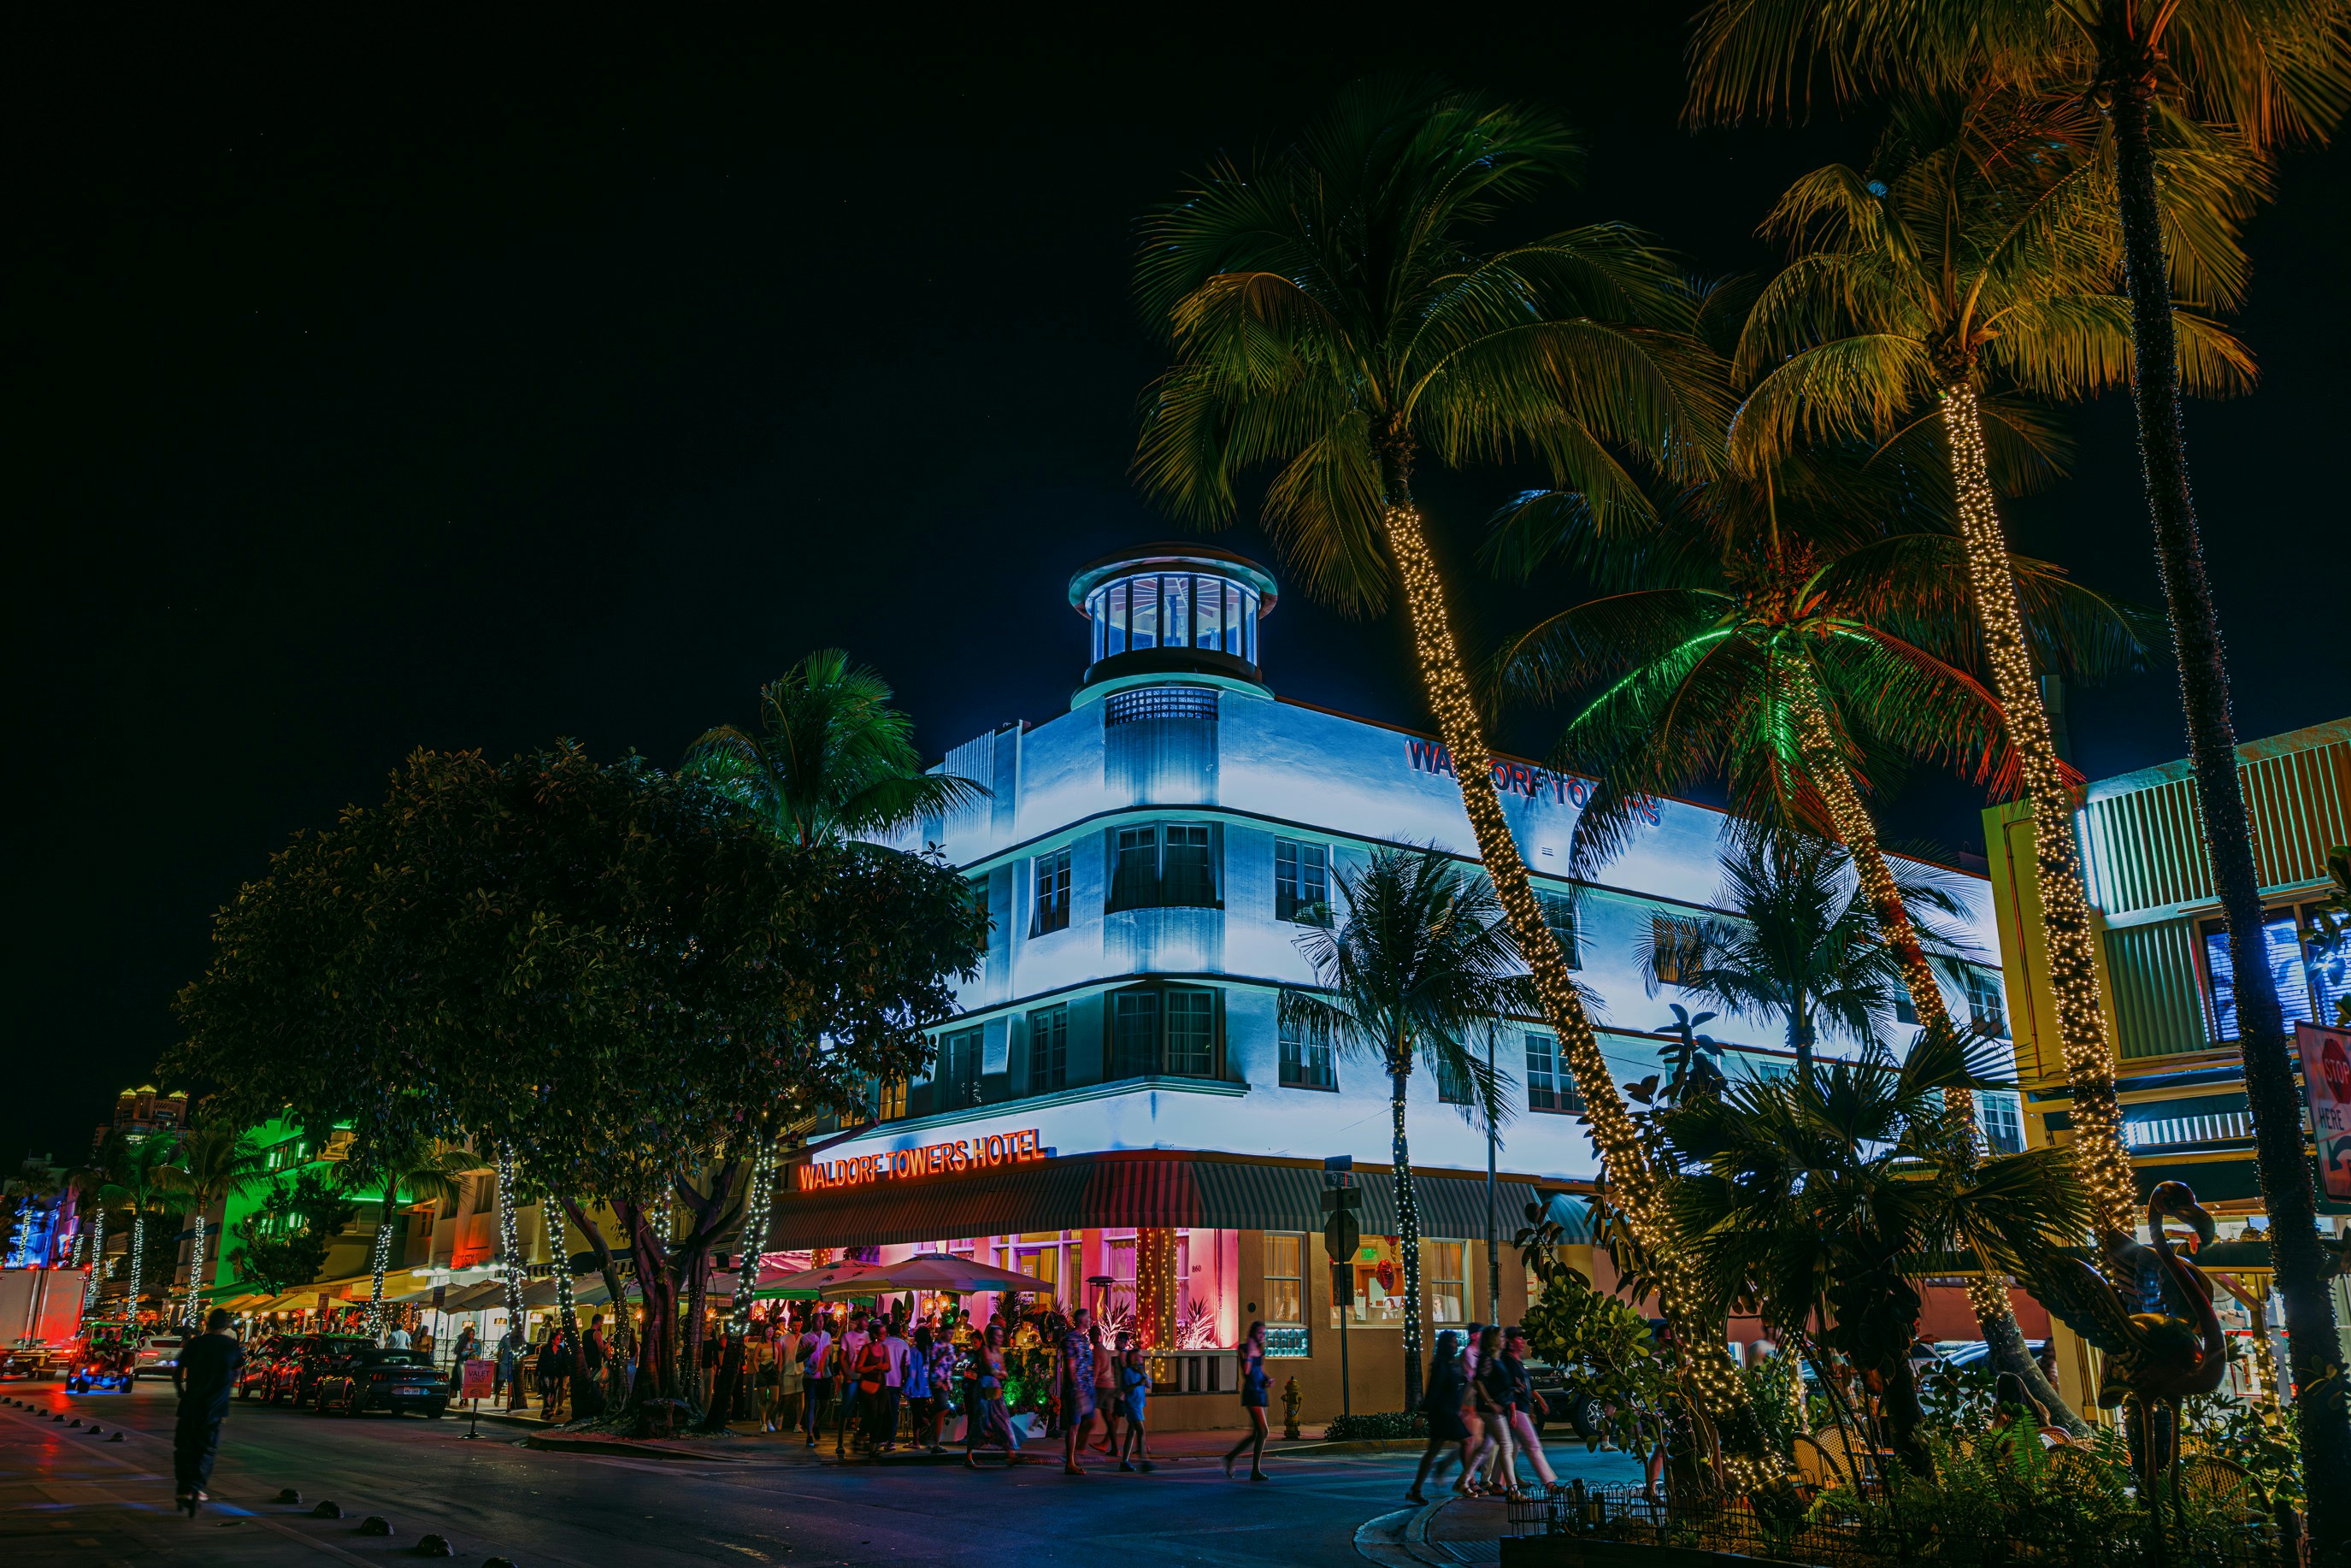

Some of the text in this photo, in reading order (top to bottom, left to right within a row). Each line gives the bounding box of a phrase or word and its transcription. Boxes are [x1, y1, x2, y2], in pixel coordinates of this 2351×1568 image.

[1405, 740, 1542, 799] WAORF
[2324, 1058, 2350, 1084] STOP
[2318, 1107, 2345, 1131] HERE
[799, 1129, 1046, 1192] WALDORF TOWERS HOTEL
[1332, 1173, 1352, 1185] 9 STEET
[1192, 1264, 1202, 1273] 860
